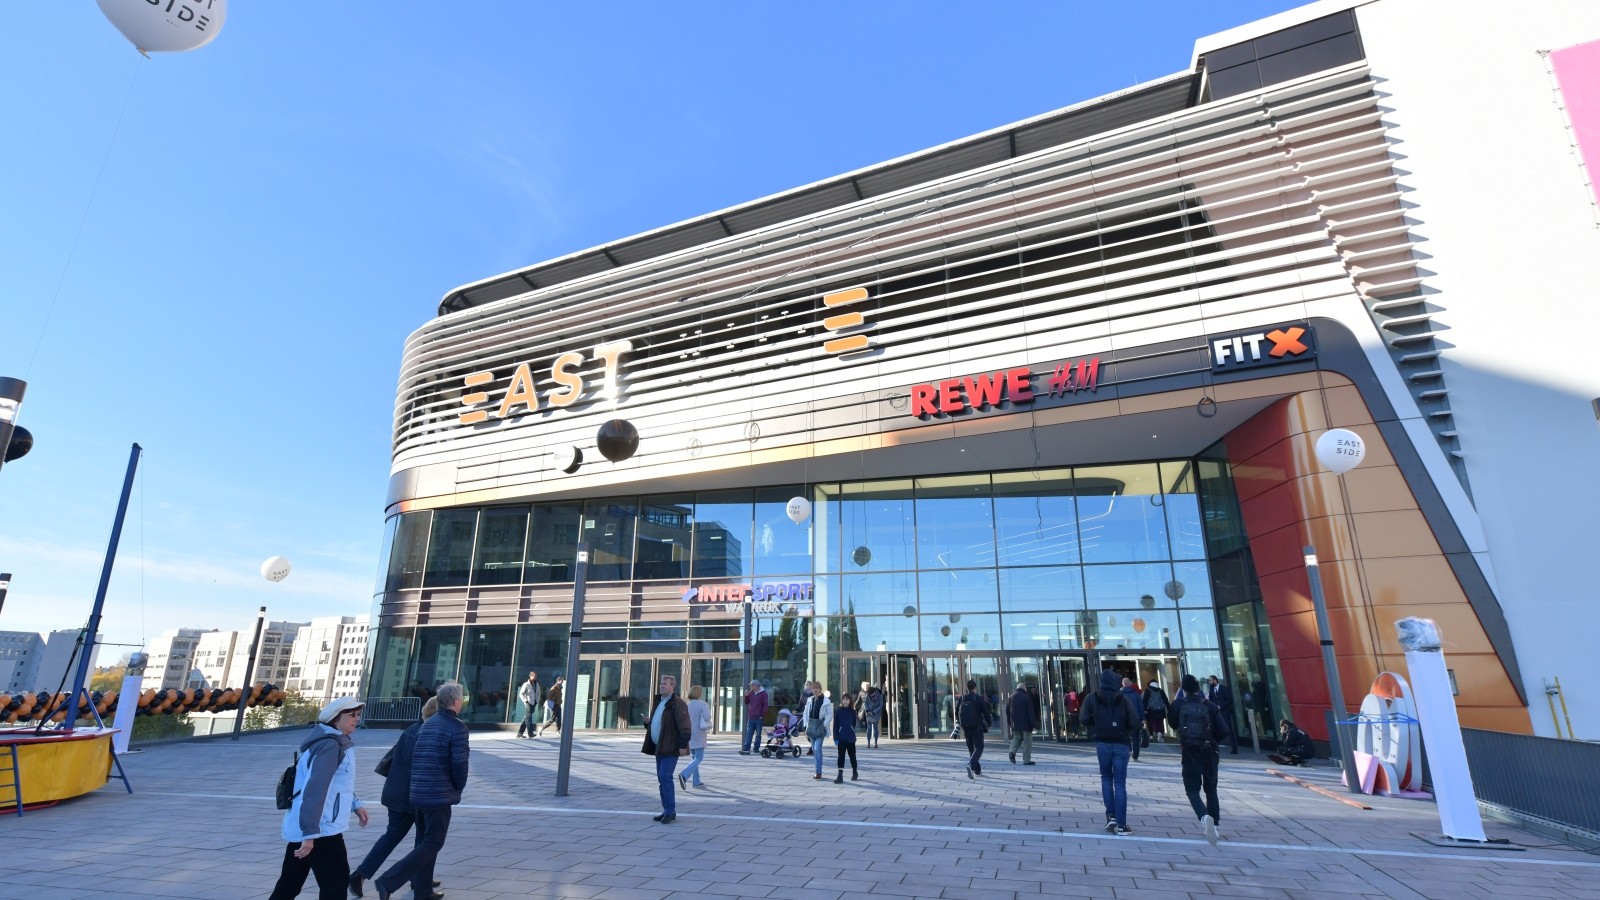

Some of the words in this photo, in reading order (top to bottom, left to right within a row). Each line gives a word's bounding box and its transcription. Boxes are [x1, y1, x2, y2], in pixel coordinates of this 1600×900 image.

[1213, 327, 1309, 366] FITX
[459, 340, 633, 425] EAST
[911, 367, 1034, 417] REWE
[1048, 357, 1099, 398] H&M
[1336, 447, 1360, 457] SIDE
[1337, 439, 1360, 448] EAST
